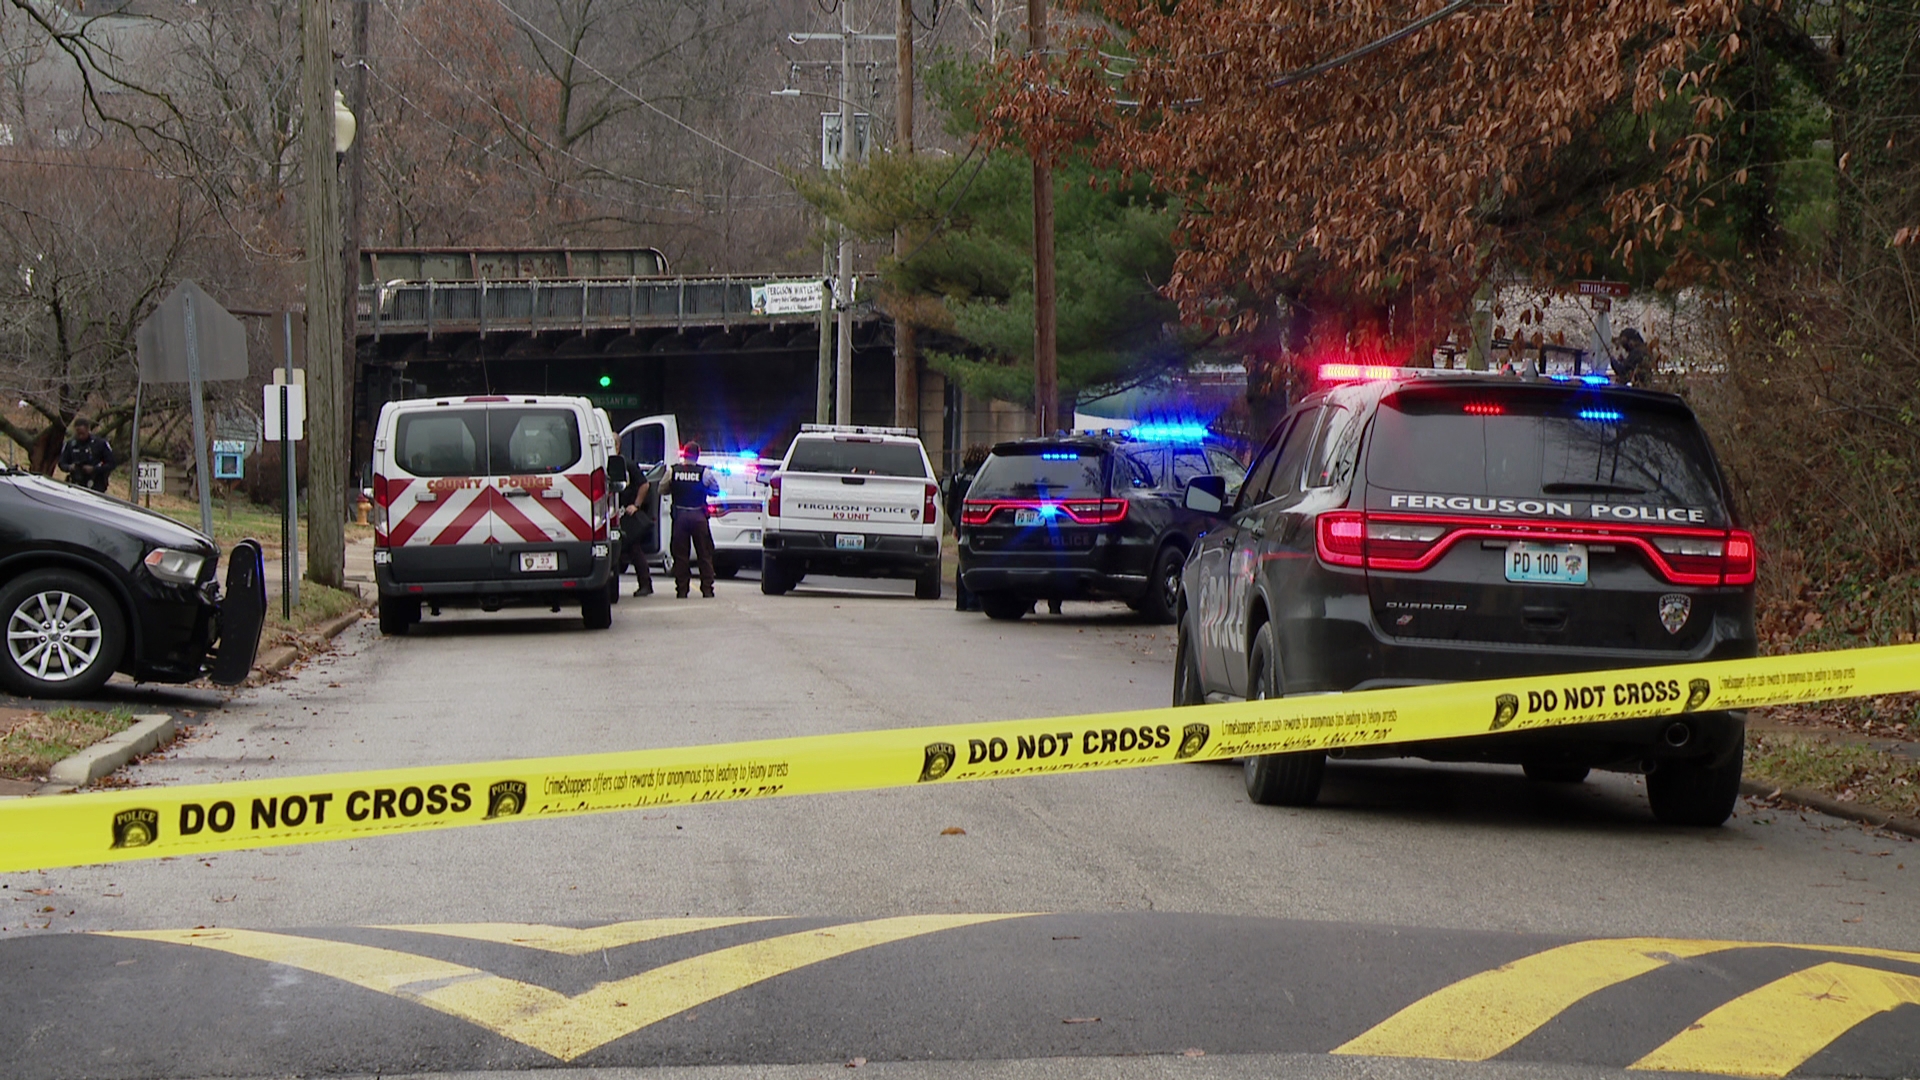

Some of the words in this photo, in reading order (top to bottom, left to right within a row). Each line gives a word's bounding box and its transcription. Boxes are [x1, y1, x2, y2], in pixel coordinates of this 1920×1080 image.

[1580, 283, 1611, 293] Miller
[138, 468, 157, 478] EXIT
[674, 471, 701, 482] POLICE
[138, 480, 159, 489] ONLY
[427, 478, 483, 490] COUNTY
[498, 477, 553, 489] POLICE
[798, 503, 860, 512] FERGUSON
[866, 506, 907, 514] POLICE
[1390, 494, 1572, 516] FERGUSON
[1590, 504, 1706, 523] POLICE
[847, 512, 870, 520] UNIT
[1514, 552, 1530, 573] PD
[1537, 553, 1558, 574] 100
[1386, 602, 1467, 611] DURANGO
[1528, 689, 1557, 713] DO
[1564, 686, 1605, 711] NOT
[1613, 679, 1681, 706] CROSS
[927, 744, 954, 757] POLICE
[968, 737, 1008, 765] DO
[1016, 732, 1073, 760] NOT
[1082, 724, 1171, 754] CROSS
[593, 772, 612, 795] offers
[614, 770, 628, 790] cash
[629, 769, 654, 789] rewards
[654, 768, 666, 791] for
[667, 769, 701, 789] anonymous
[703, 764, 715, 786] tips
[716, 763, 738, 785] leading
[739, 764, 747, 780] to
[746, 760, 767, 783] felony
[768, 760, 788, 778] arrests
[491, 781, 525, 796] POLICE
[179, 800, 236, 836] DO
[251, 793, 333, 830] NOT
[346, 783, 472, 821] CROSS
[116, 810, 157, 825] POLICE
